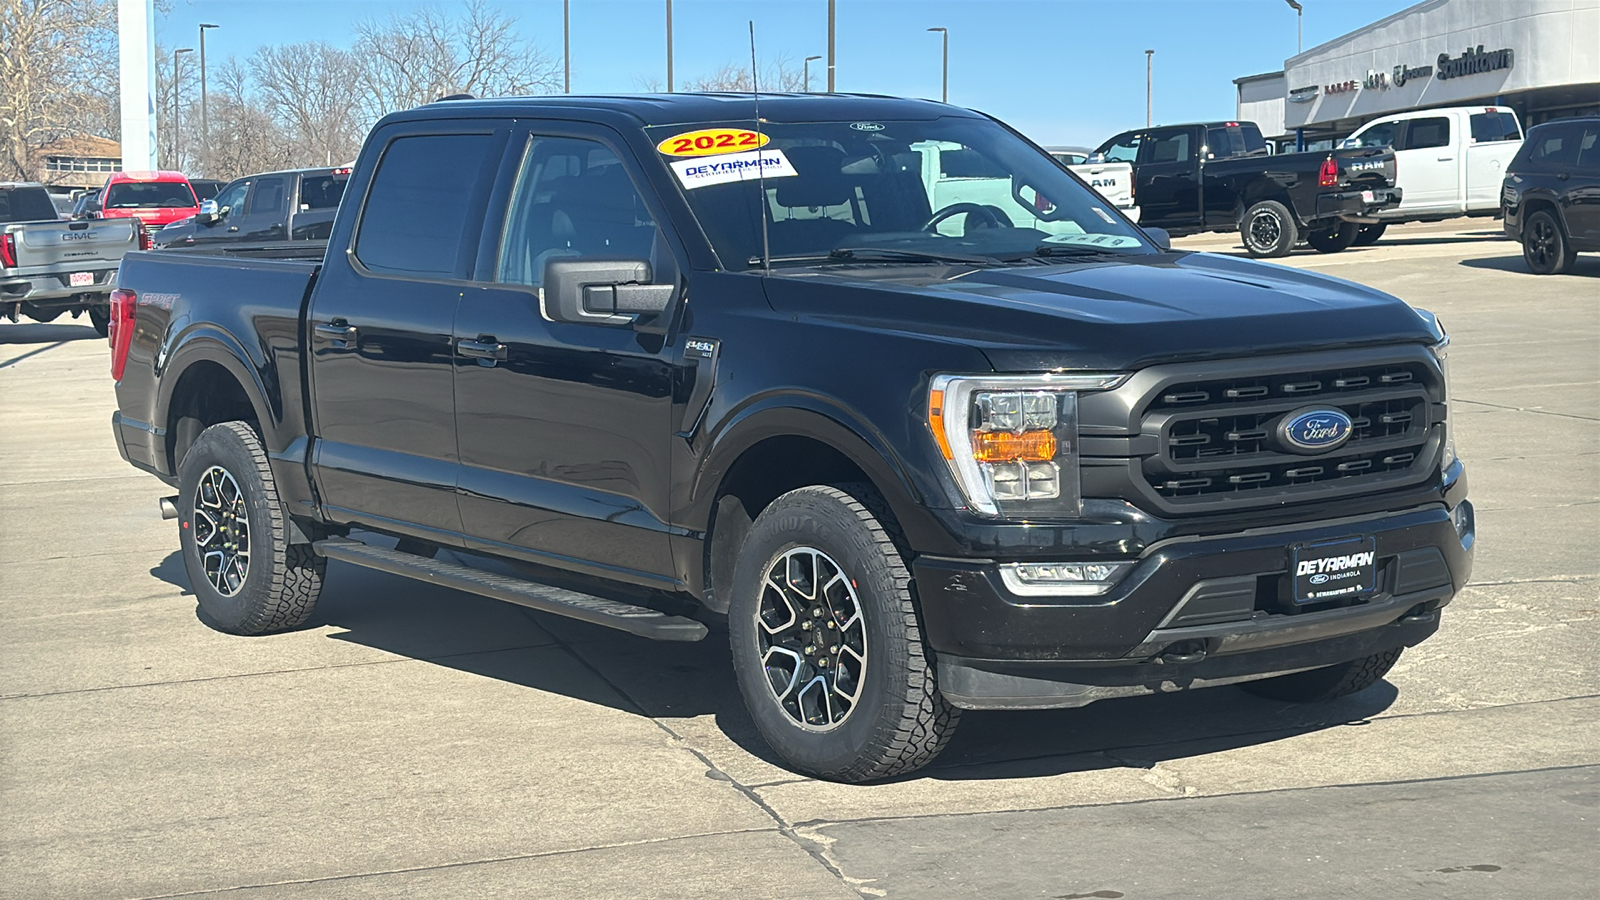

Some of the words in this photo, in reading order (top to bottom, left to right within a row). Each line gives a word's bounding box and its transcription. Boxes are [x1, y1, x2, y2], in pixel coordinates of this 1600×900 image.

[1437, 44, 1514, 80] Southtown
[857, 123, 879, 131] Ford
[673, 132, 758, 153] 2022
[685, 158, 780, 176] DEYARMAN
[1351, 160, 1385, 171] RAM
[62, 232, 98, 241] GMC
[1303, 418, 1339, 440] Ford
[1296, 552, 1374, 576] DEYARMAN
[1330, 570, 1361, 581] INDIANOLA
